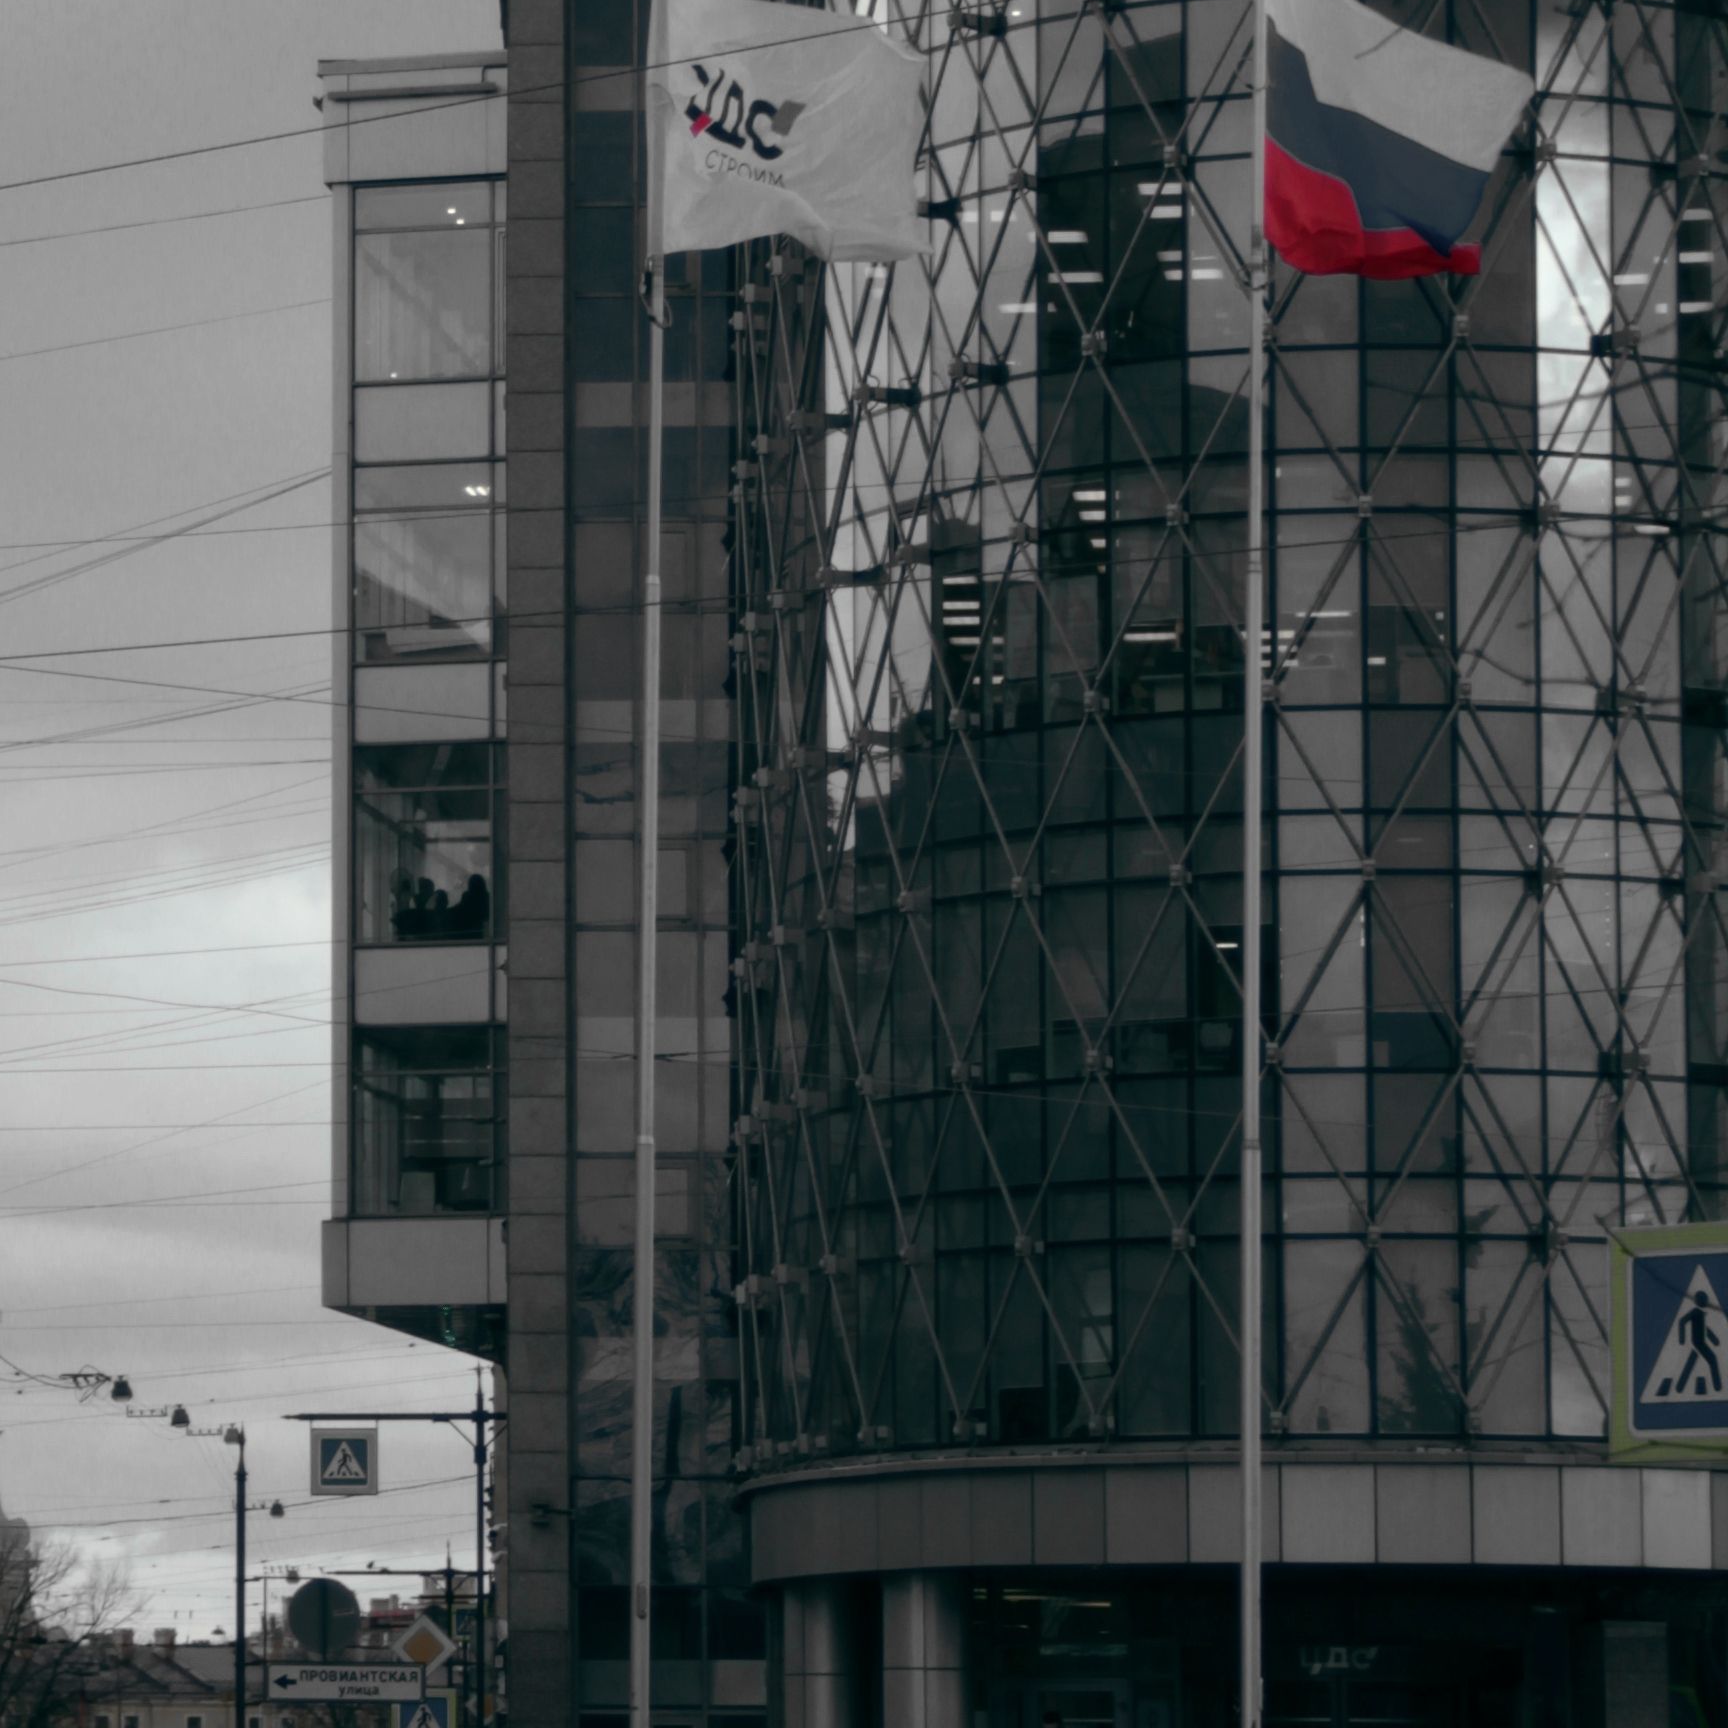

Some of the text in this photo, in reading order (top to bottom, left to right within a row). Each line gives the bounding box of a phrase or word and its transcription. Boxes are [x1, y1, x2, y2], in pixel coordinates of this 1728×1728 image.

[704, 148, 786, 190] СТРОИМ
[299, 1669, 419, 1683] ПРОВИАНТСКАЯ
[338, 1684, 380, 1698] улица
